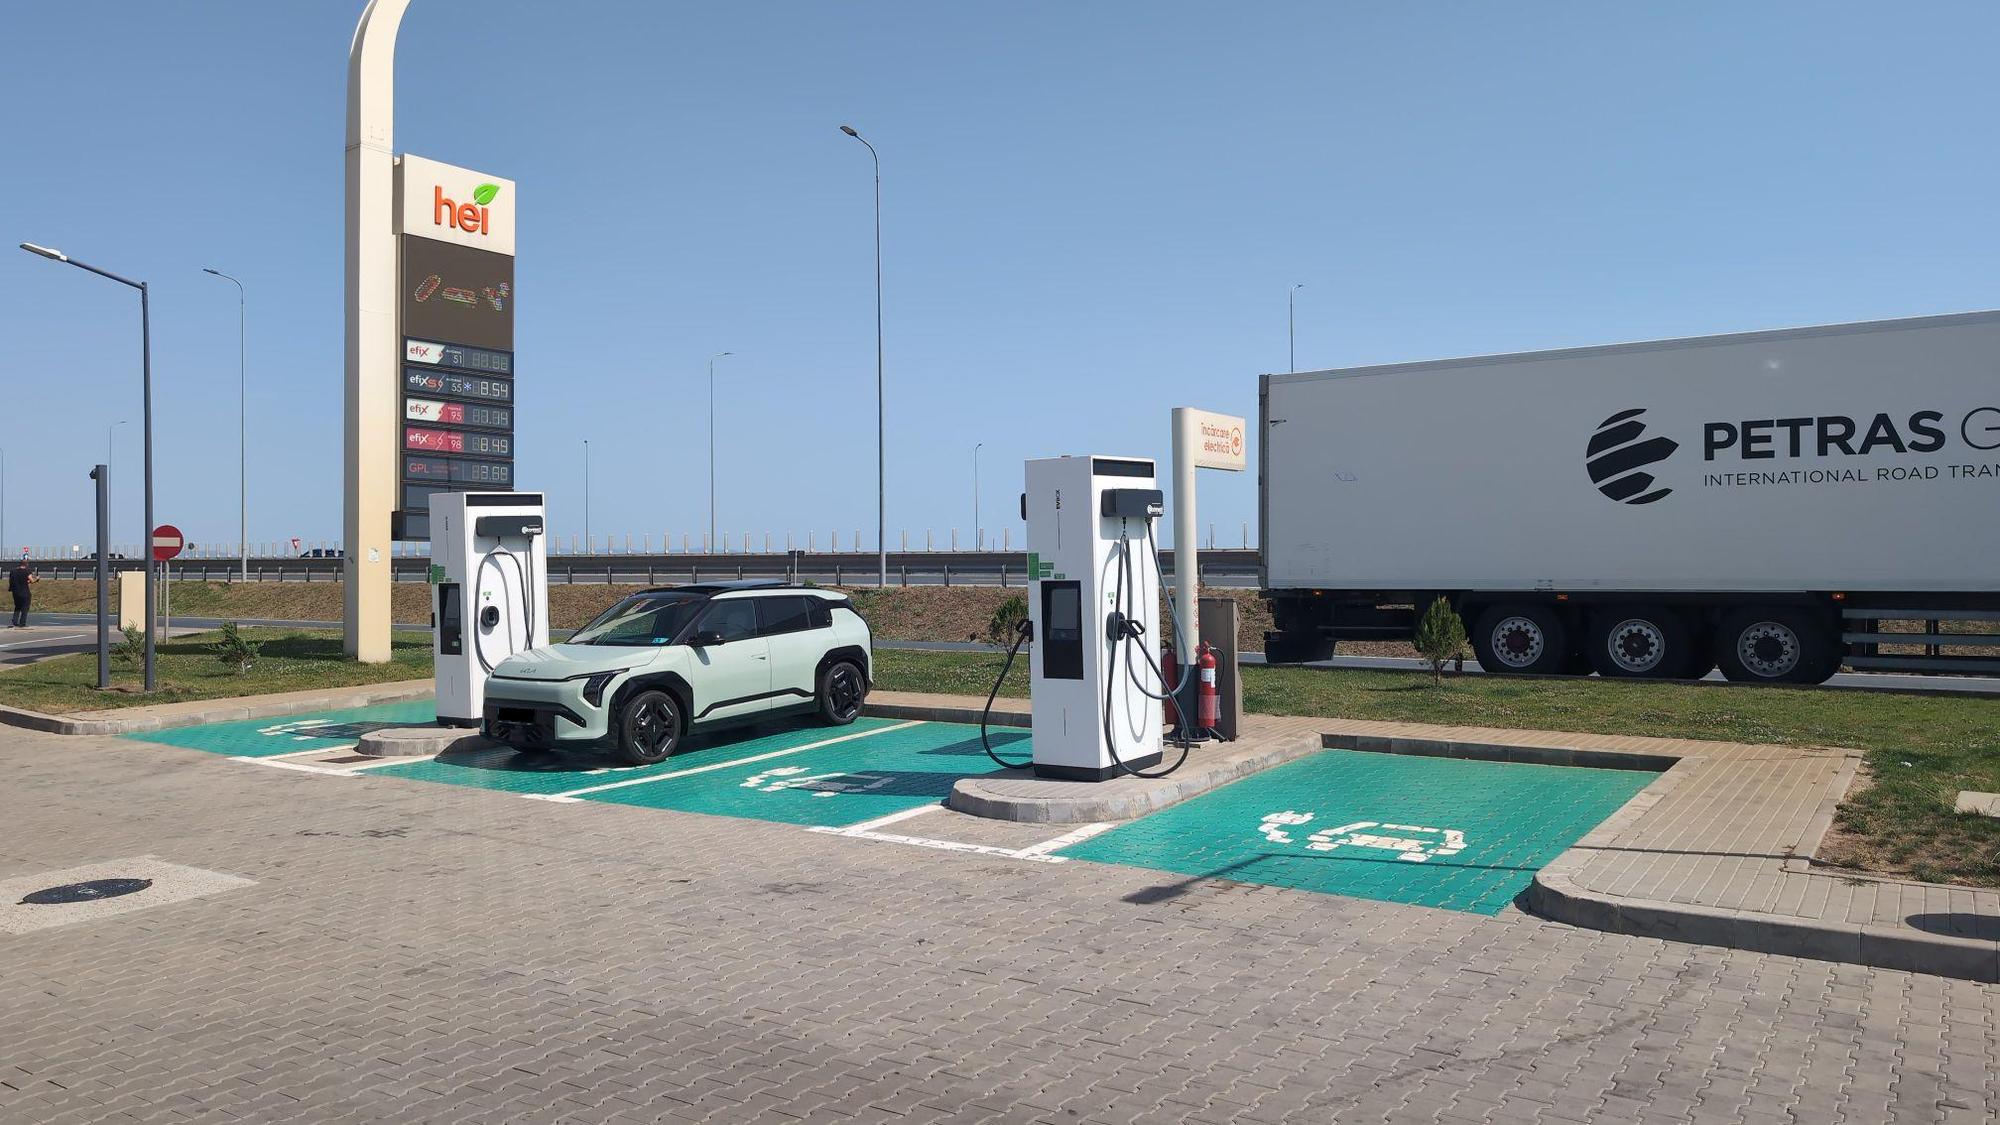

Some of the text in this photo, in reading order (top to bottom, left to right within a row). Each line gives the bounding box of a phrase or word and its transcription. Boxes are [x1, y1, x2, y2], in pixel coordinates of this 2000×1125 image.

[434, 185, 489, 235] hei
[409, 345, 430, 358] efix
[453, 354, 463, 365] 51
[451, 383, 463, 393] 55
[480, 381, 508, 398] 8.54
[409, 403, 429, 416] efix
[451, 411, 462, 421] 95
[451, 439, 462, 450] 98
[480, 437, 508, 453] 8.49
[1704, 410, 1946, 461] PETRAS
[409, 463, 430, 474] GPL
[1704, 469, 1868, 487] INTERNATIONAL
[1877, 466, 1938, 481] ROAD
